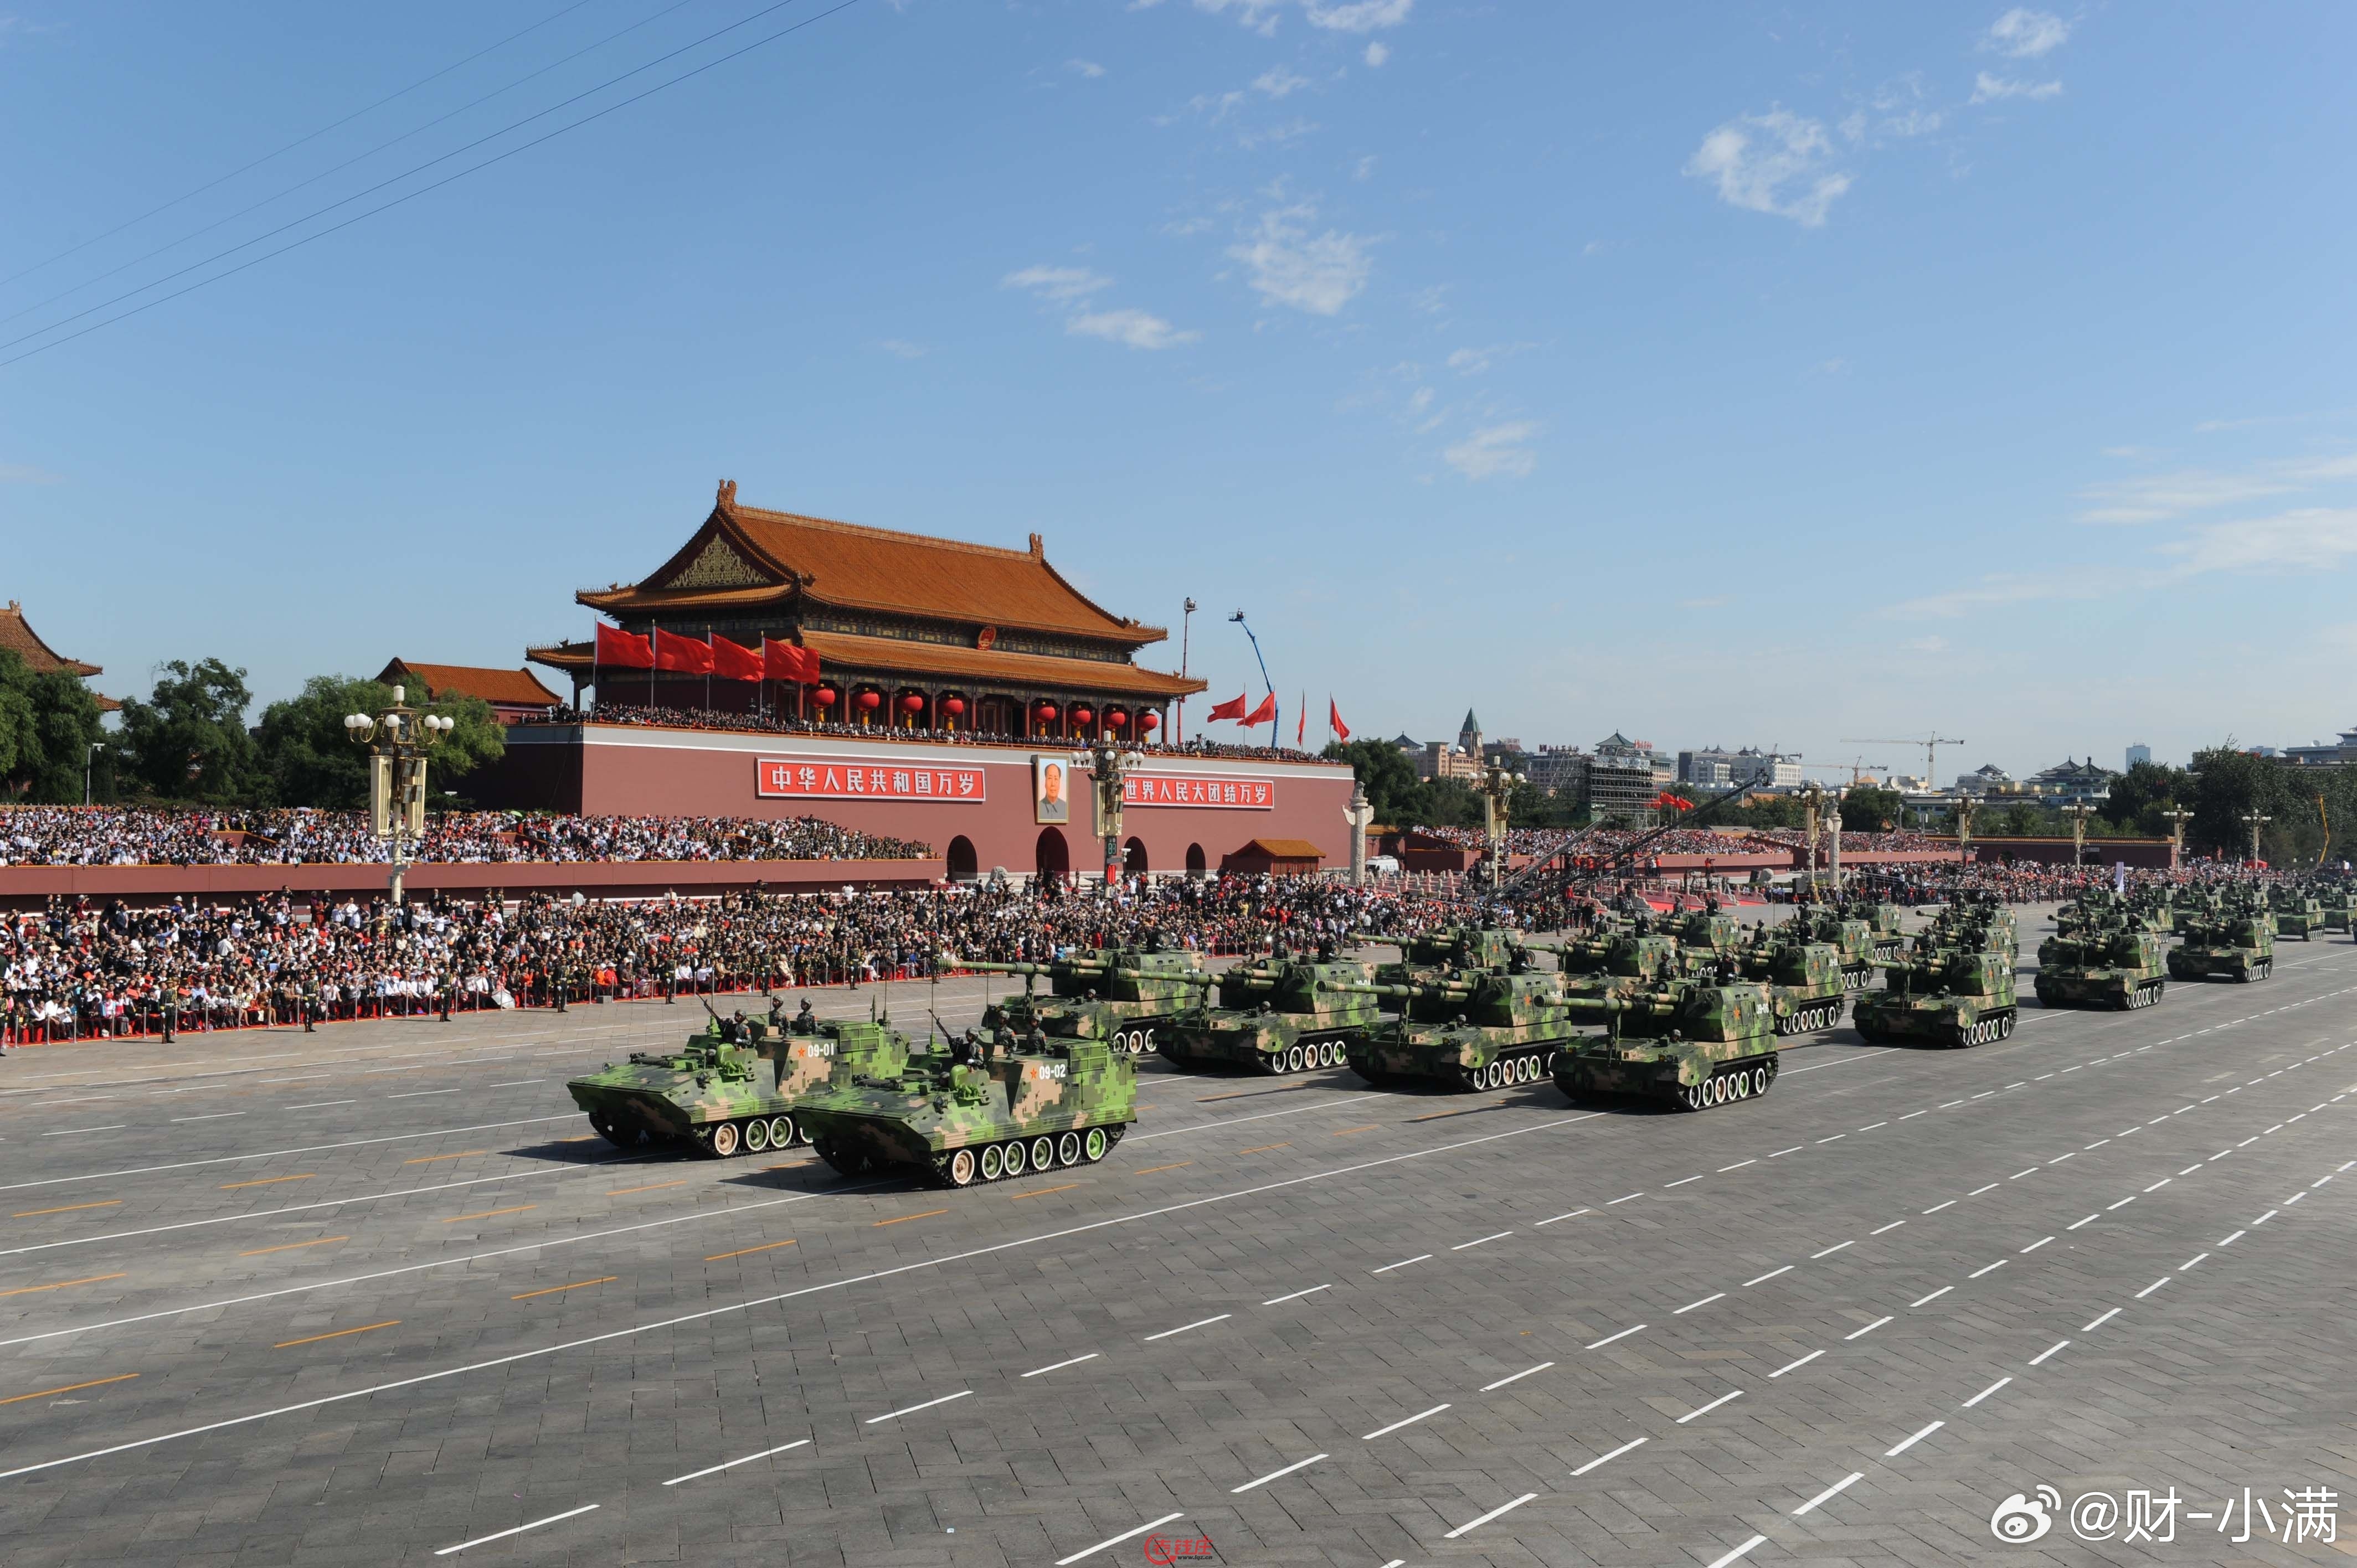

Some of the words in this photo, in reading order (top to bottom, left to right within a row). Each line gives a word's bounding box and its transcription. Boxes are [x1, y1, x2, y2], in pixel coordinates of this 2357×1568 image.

[771, 765, 974, 796] 中华人民共和国万岁
[1124, 780, 1267, 803] 世界人民大团结万岁
[807, 1043, 835, 1058] 09-01
[1039, 1064, 1066, 1080] 09-02
